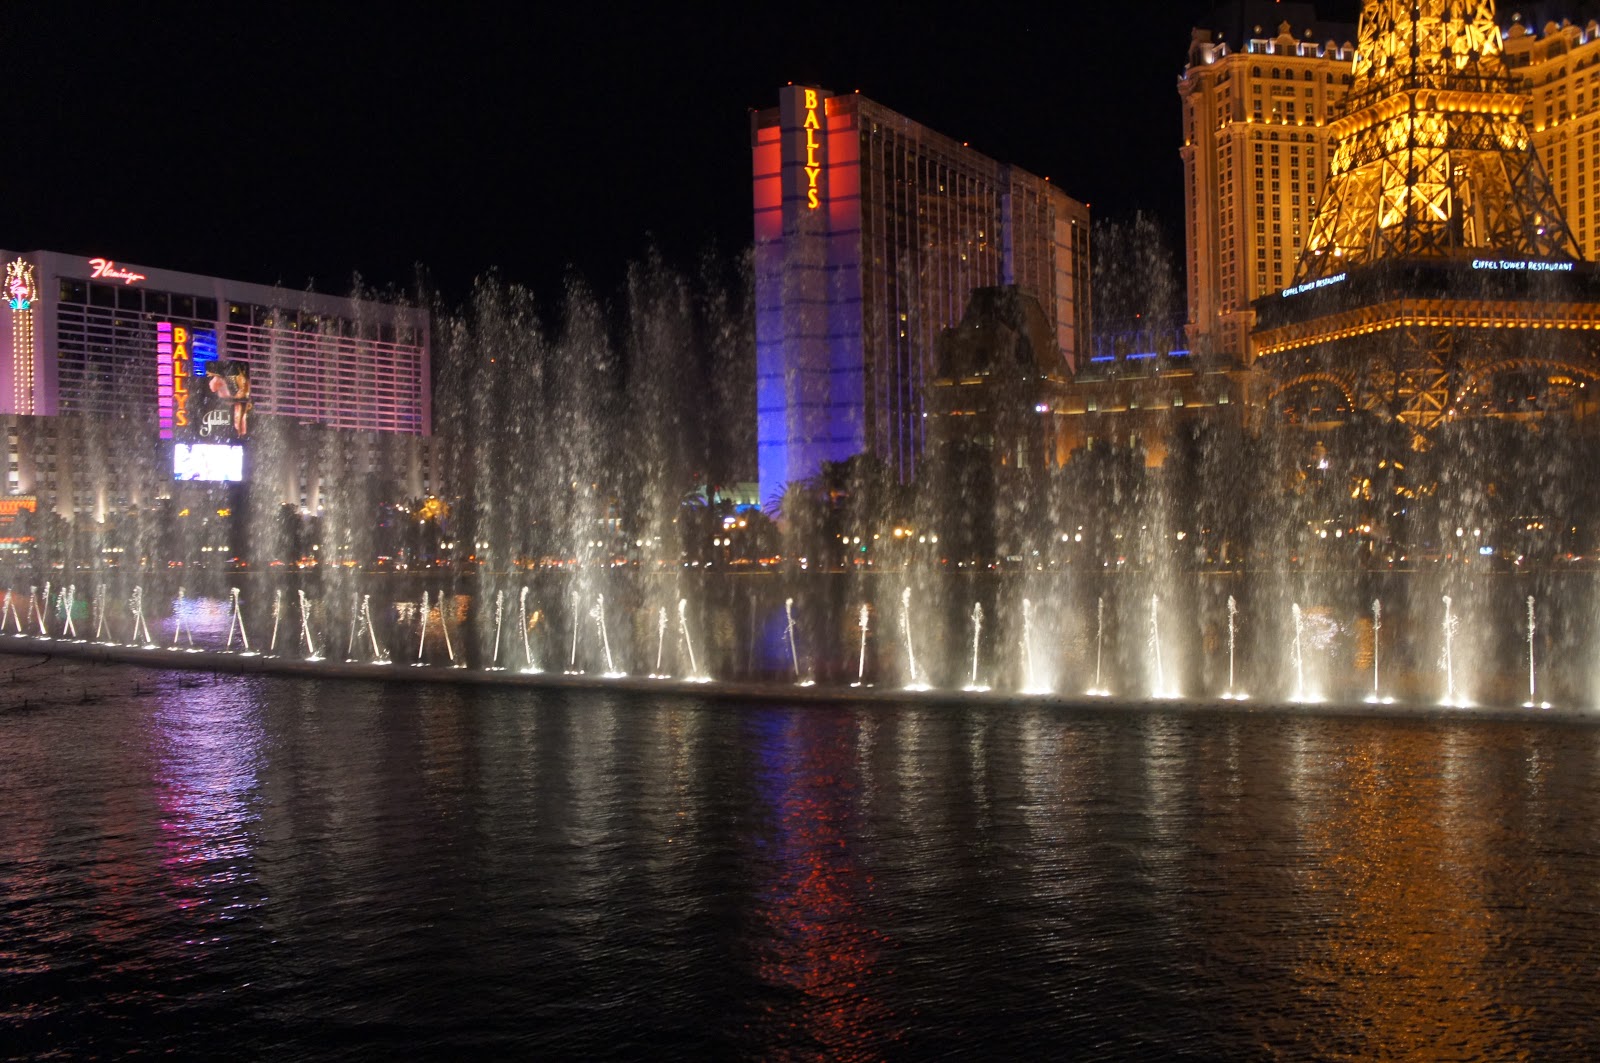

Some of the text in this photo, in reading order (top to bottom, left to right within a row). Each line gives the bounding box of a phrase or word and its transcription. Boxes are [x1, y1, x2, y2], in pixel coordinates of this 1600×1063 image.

[88, 257, 146, 285] Flamingo
[1472, 259, 1573, 271] EIFFEL TOWER RESTAURANT
